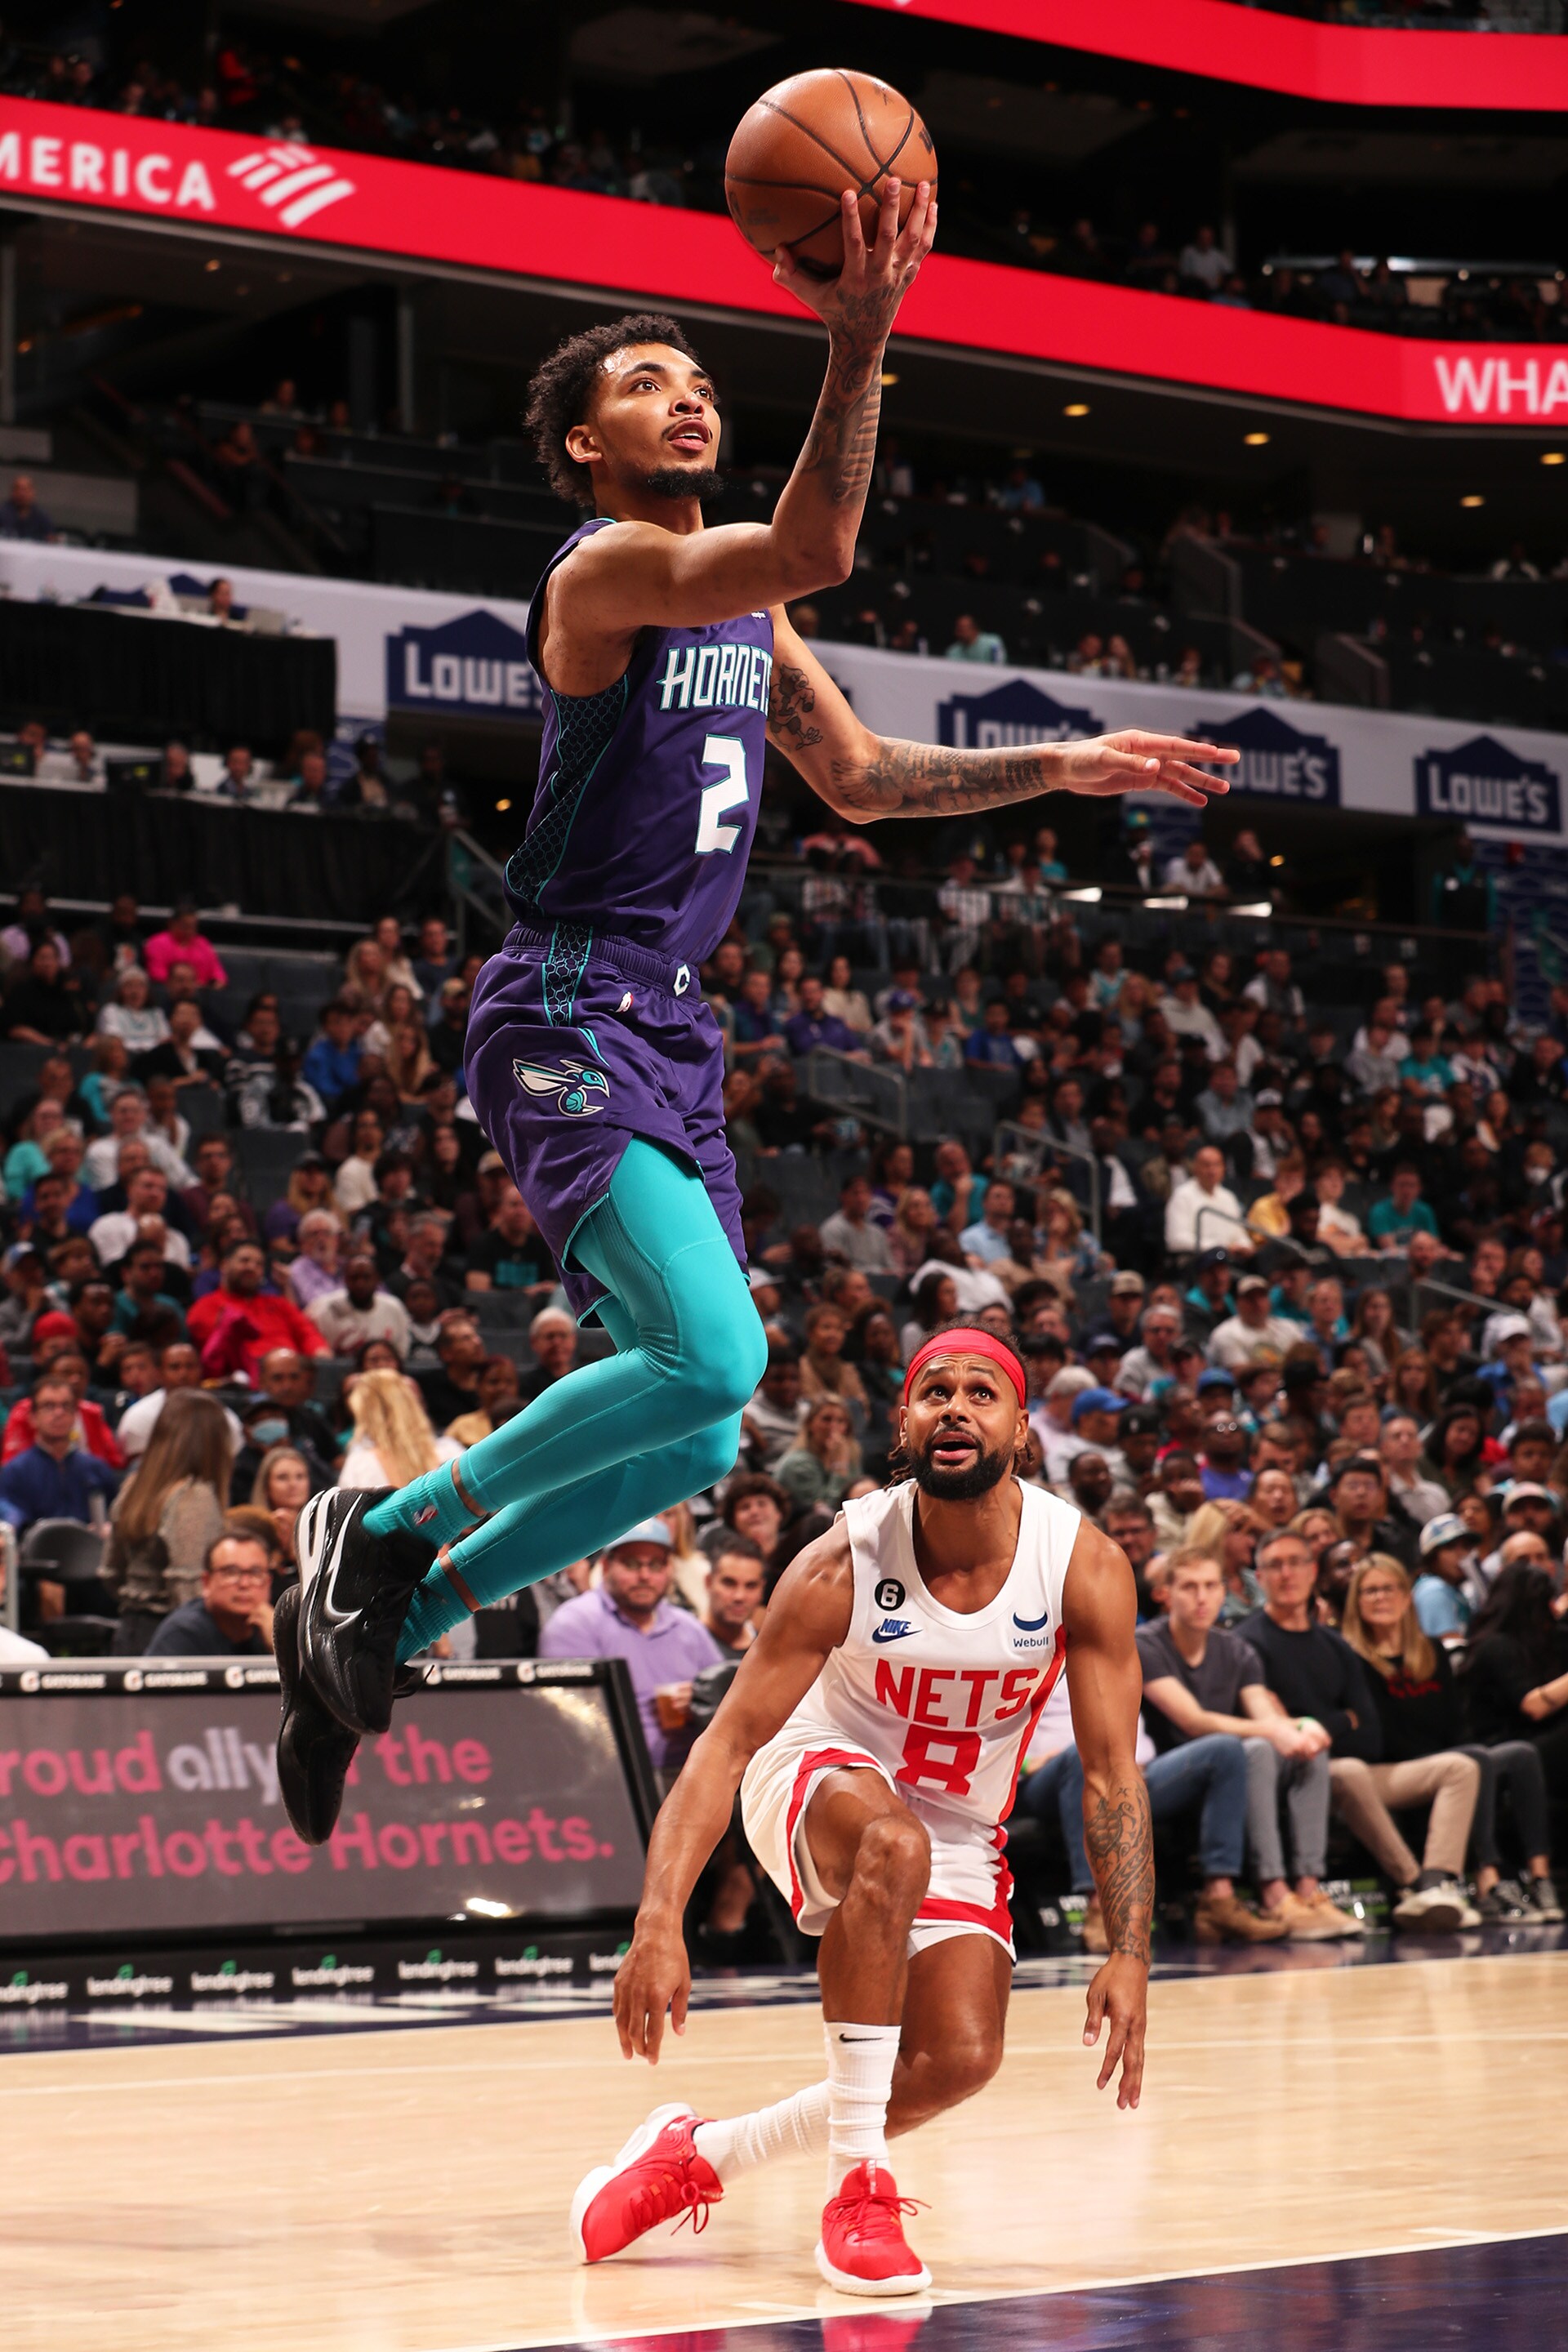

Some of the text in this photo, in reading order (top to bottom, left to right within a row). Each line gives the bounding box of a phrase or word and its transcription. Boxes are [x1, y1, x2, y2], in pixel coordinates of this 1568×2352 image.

[695, 733, 750, 853] 2
[1428, 762, 1548, 824] LOWE'S
[880, 1583, 898, 1608] 6
[880, 1618, 911, 1634] NIKE
[1013, 1636, 1049, 1648] Webull
[875, 1658, 1040, 1728] NETS
[167, 1727, 283, 1806] ally
[376, 1724, 492, 1787] the
[894, 1723, 982, 1797] 8
[328, 1807, 614, 1870] Hornets.
